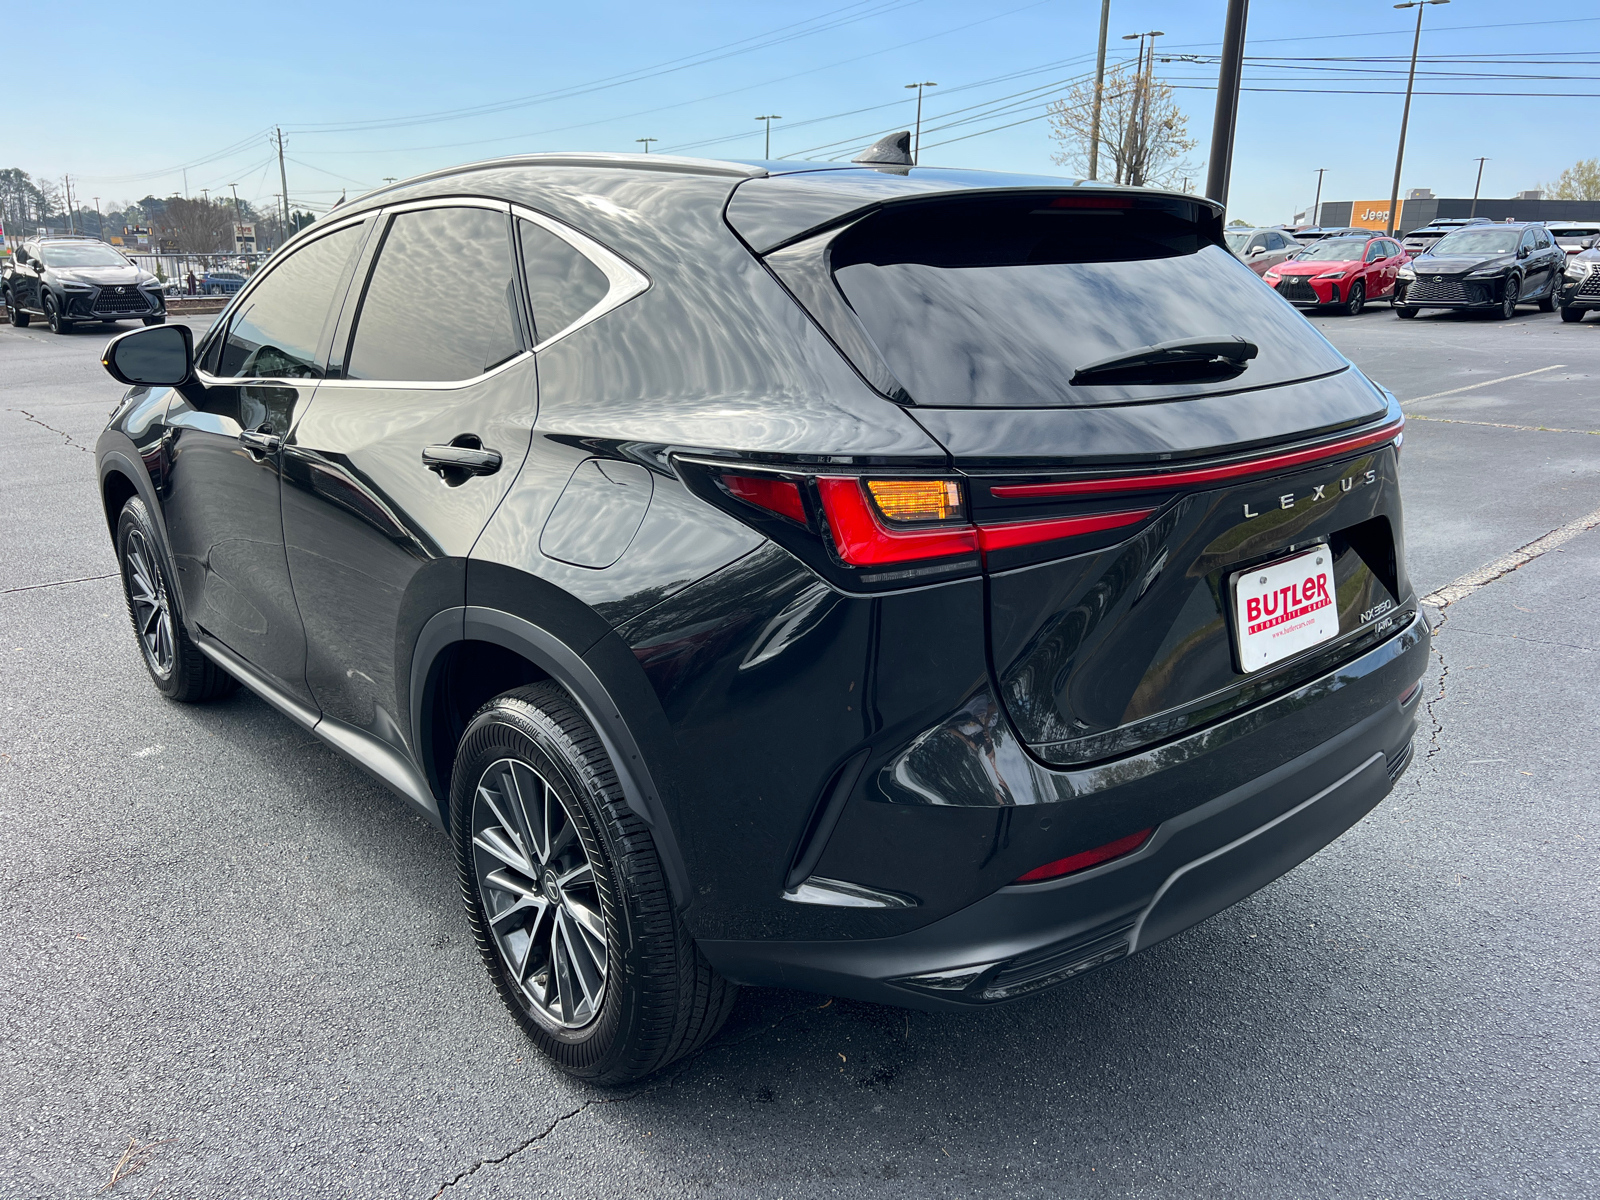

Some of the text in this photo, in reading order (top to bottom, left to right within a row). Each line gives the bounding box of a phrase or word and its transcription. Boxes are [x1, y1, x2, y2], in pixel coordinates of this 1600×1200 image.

[1361, 208, 1390, 223] Jeep
[1243, 469, 1376, 518] LEXUS
[1248, 597, 1331, 634] AUTOMOTIVE GROUP
[1360, 599, 1392, 624] NX350
[1272, 618, 1316, 638] www.butlercars.com
[499, 710, 541, 740] BRIDGESTONE
